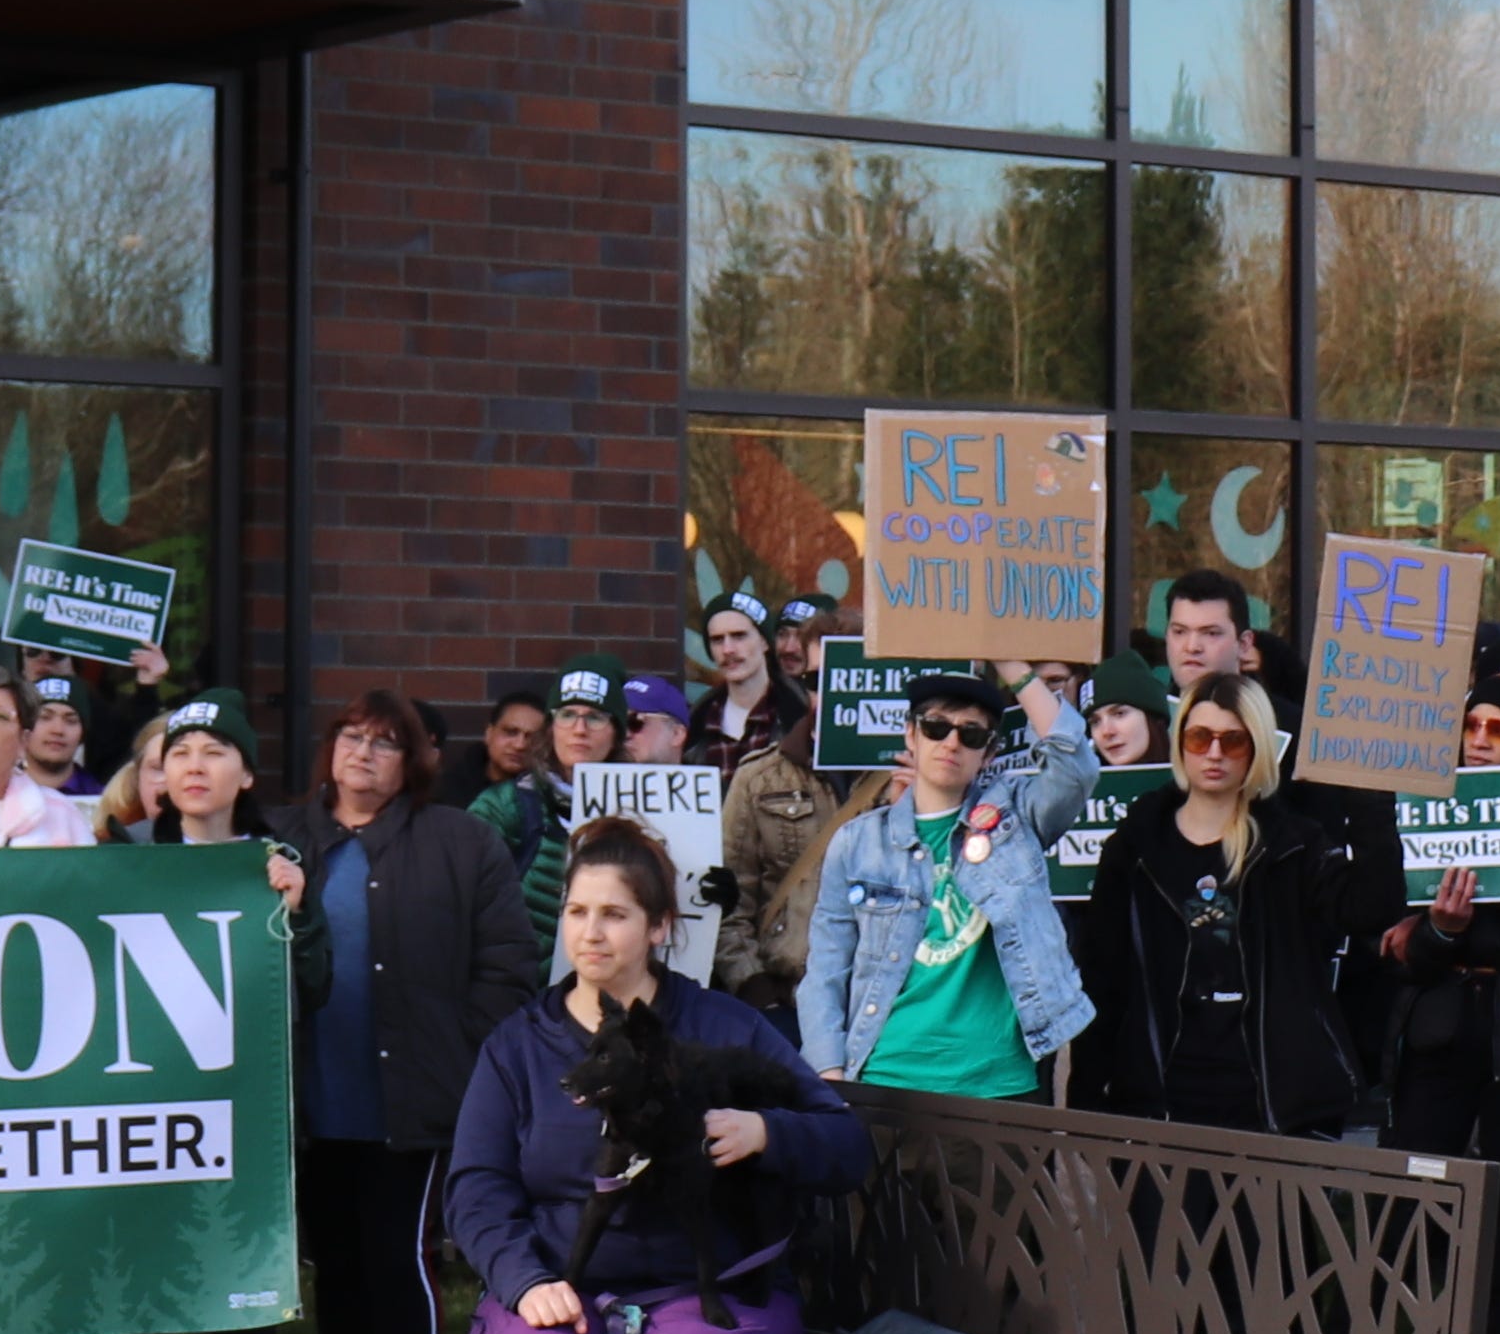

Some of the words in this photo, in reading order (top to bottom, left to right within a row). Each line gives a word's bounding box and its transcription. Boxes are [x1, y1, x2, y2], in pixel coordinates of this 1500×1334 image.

[902, 429, 1007, 506] REI
[881, 512, 1095, 559] CO-OPERATE
[23, 565, 72, 591] REI:
[73, 574, 107, 599] It's
[110, 581, 163, 610] Time
[874, 555, 969, 614] WITH
[986, 556, 1103, 621] UNIONS
[1332, 551, 1450, 647] REI
[24, 592, 46, 613] to
[49, 596, 151, 635] Negotiate.
[561, 670, 608, 699] REI
[830, 668, 881, 693] REI:
[885, 666, 917, 693] It'
[1320, 639, 1450, 697] READILY
[833, 702, 858, 727] to
[1315, 684, 1457, 733] EXPLOITING
[1309, 728, 1453, 777] INDIVIDUALS
[581, 770, 715, 817] WHERE
[1086, 795, 1128, 823] It's
[1426, 797, 1470, 825] It's
